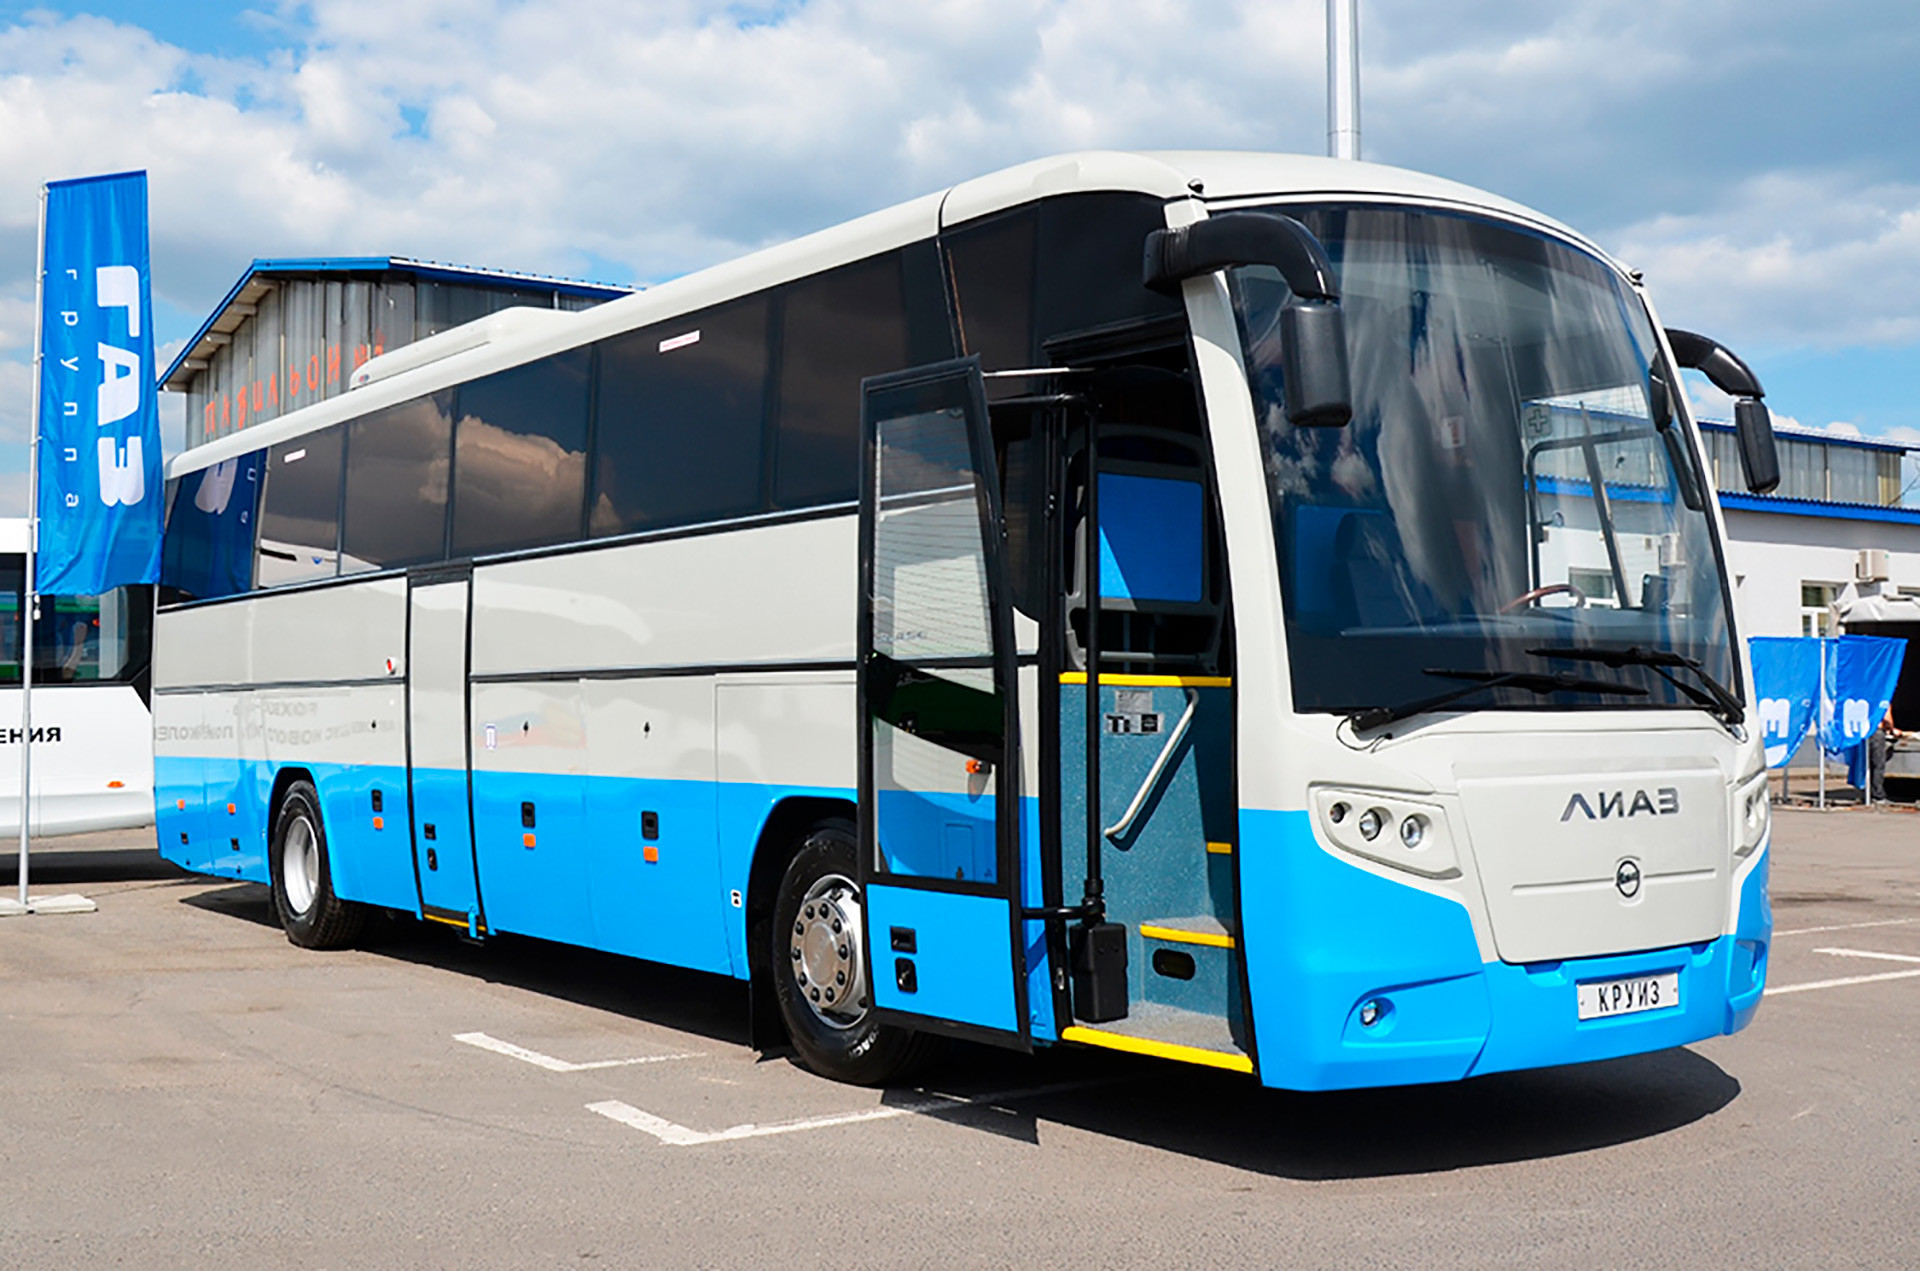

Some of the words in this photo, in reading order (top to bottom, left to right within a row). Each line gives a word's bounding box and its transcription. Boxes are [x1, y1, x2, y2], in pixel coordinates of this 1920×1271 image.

[60, 268, 79, 507] группа
[96, 265, 145, 506] ГАЗ
[1560, 787, 1679, 821] ЛИАЗ
[1598, 980, 1660, 1012] КРУИЗ
